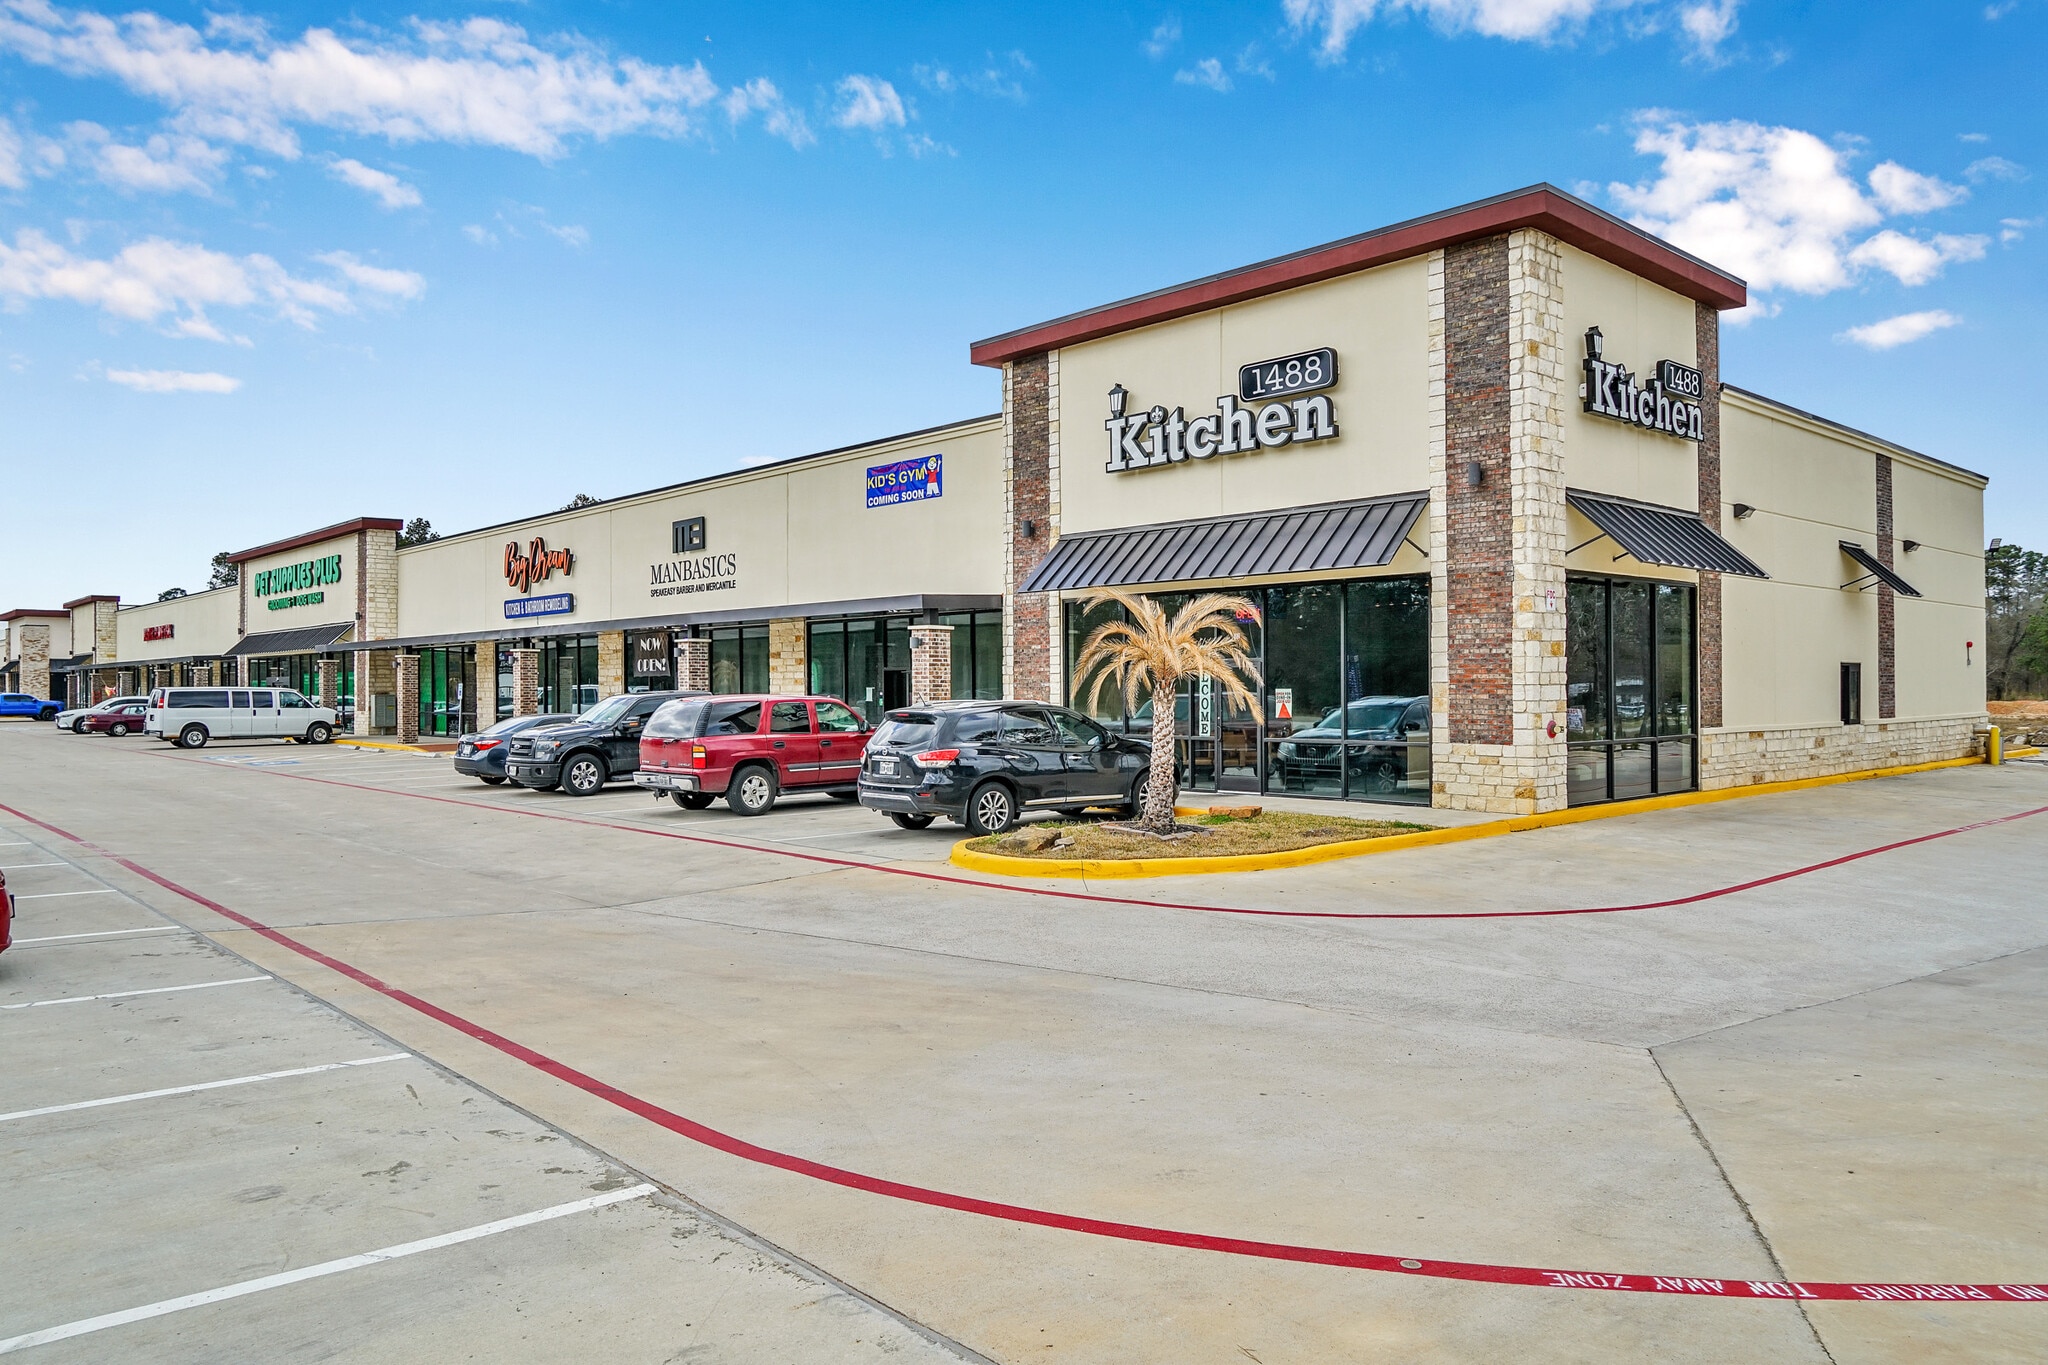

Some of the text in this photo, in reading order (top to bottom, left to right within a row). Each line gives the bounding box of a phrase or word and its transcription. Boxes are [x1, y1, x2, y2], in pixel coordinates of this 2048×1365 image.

[1252, 355, 1323, 395] 1488
[1669, 366, 1700, 395] 1488
[1586, 359, 1704, 441] Kitchen
[1106, 394, 1339, 473] Kitchen
[867, 473, 896, 489] KID'S
[899, 467, 925, 483] GYM
[868, 493, 899, 506] COMING
[901, 489, 924, 501] SOON
[504, 536, 574, 593] Big Dream
[650, 553, 736, 585] MANBASICS
[255, 554, 342, 597] PET SUPPLIES PLUS
[650, 580, 736, 597] SPEAKEASY BARBER AND MERCANTILE
[640, 637, 662, 651] NOW
[637, 658, 666, 672] OPEN!
[1542, 1272, 1632, 1289] ZONE
[1653, 1276, 1725, 1294] AWAY
[1745, 1281, 1818, 1298] TOW
[1851, 1285, 1993, 1299] PARKING
